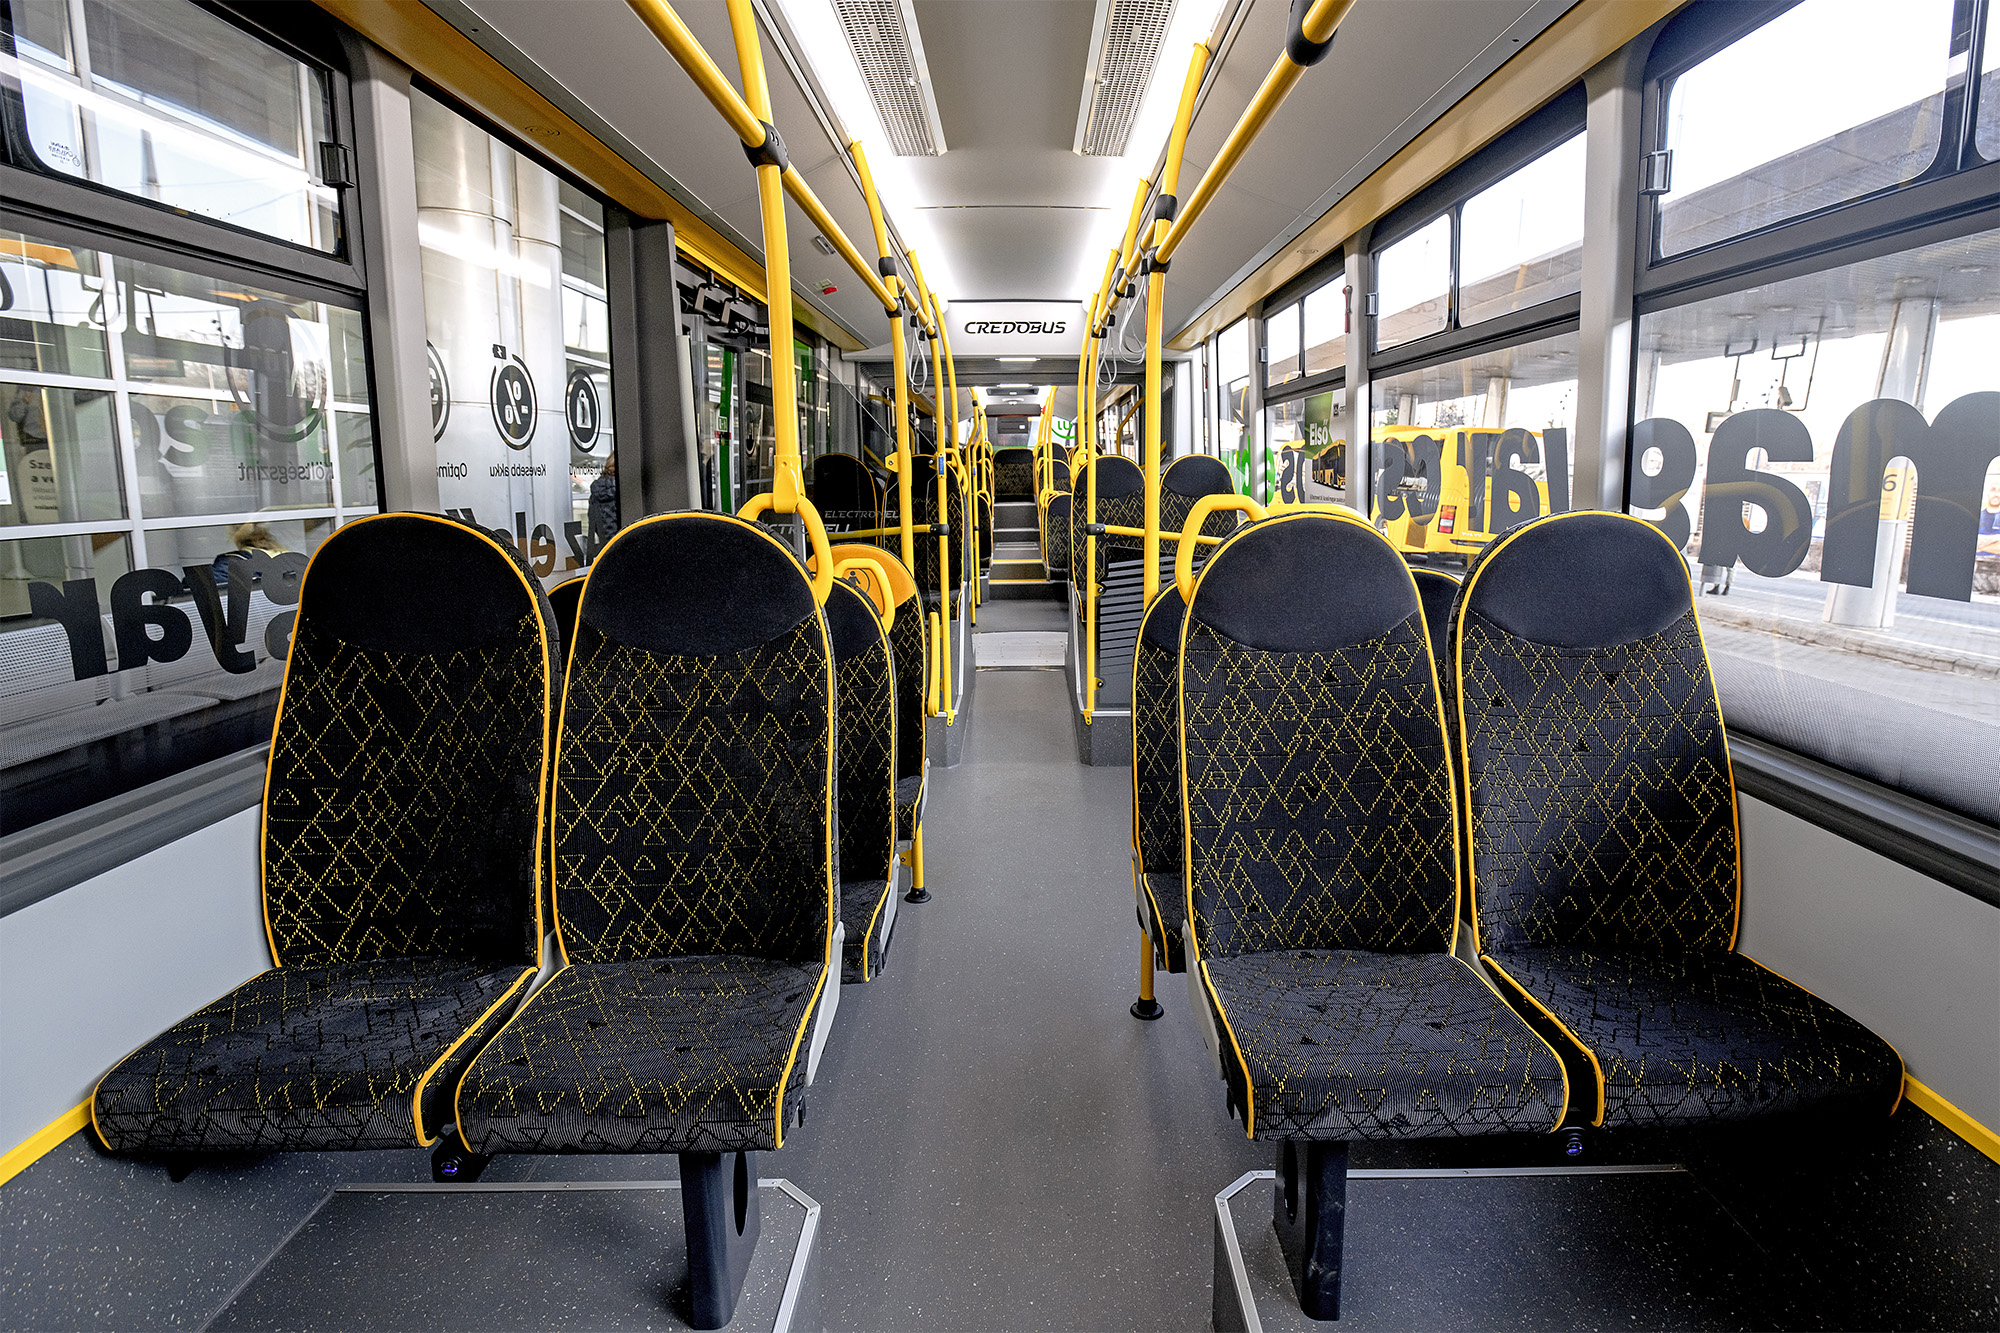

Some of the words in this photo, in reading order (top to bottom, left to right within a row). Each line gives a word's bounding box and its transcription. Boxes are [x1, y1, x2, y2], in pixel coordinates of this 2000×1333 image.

[964, 321, 1067, 335] CREDOBUS
[1309, 418, 1329, 446] Első
[1882, 474, 1898, 492] 6
